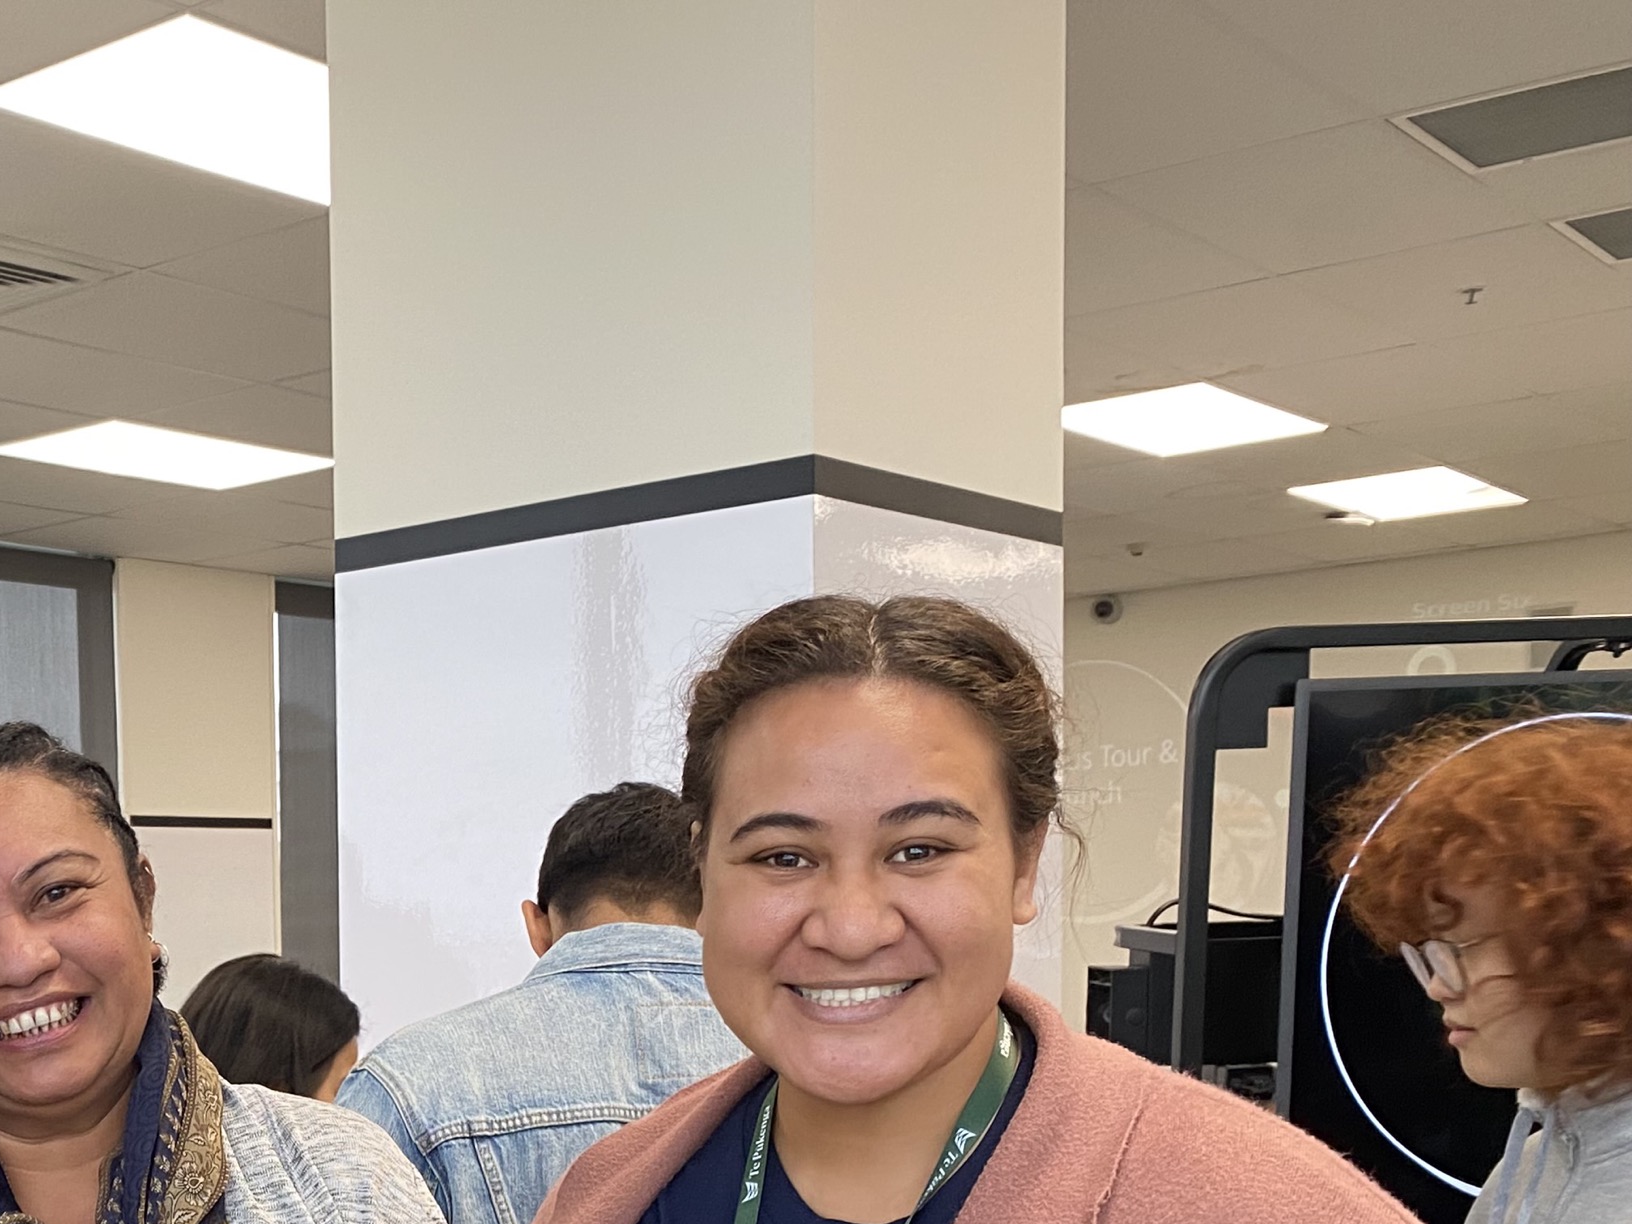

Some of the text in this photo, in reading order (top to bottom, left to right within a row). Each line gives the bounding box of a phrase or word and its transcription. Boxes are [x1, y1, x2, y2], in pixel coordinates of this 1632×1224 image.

[1100, 744, 1152, 768] Tour
[1159, 739, 1179, 764] &
[748, 1161, 761, 1179] Te
